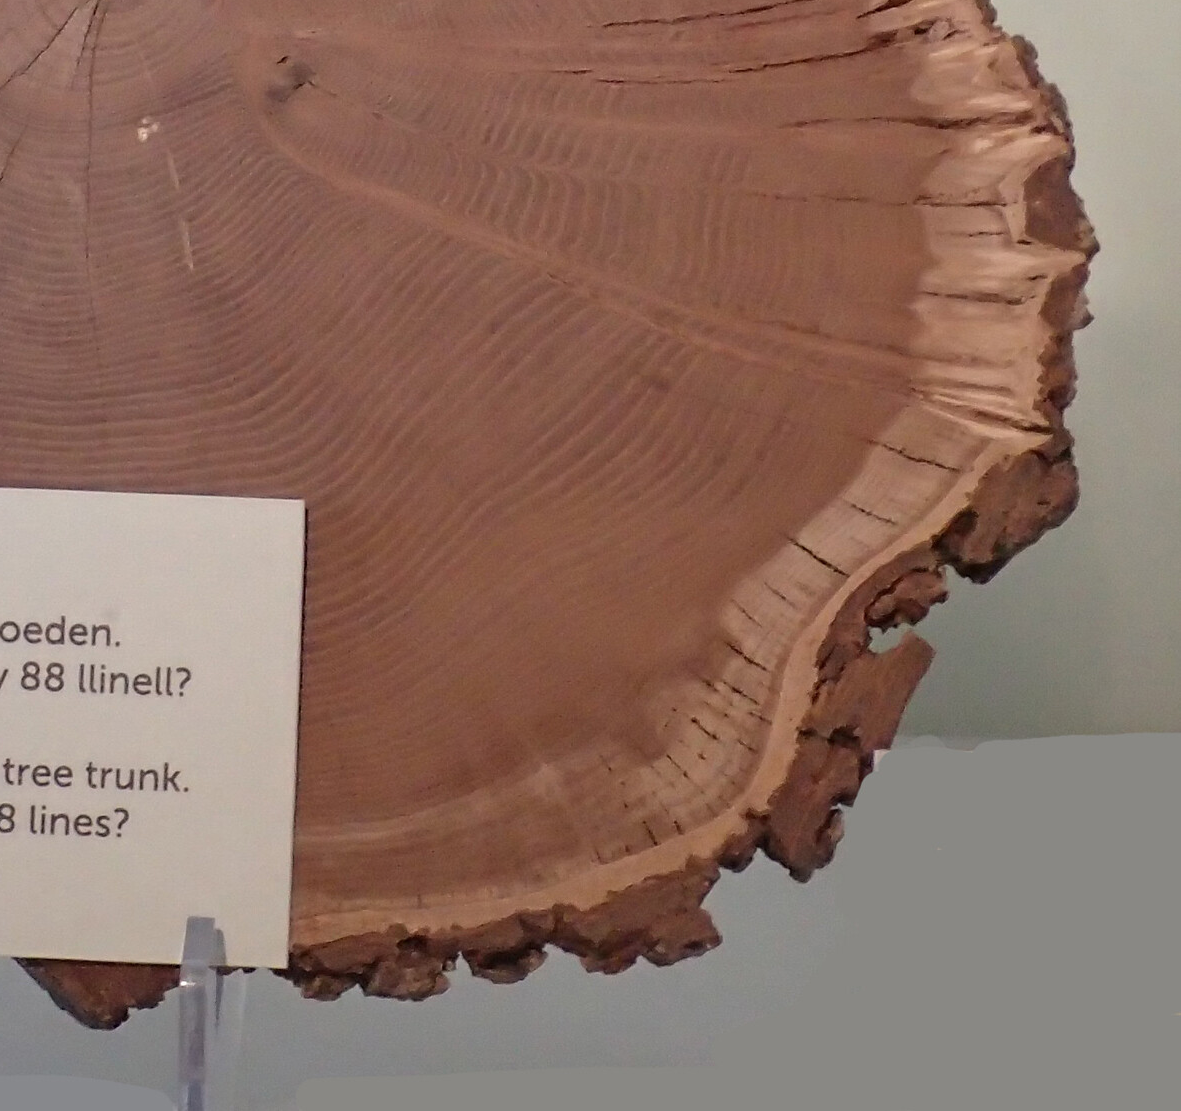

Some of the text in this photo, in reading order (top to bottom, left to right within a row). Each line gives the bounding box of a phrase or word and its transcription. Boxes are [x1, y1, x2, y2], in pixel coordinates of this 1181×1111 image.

[21, 661, 64, 692] 88
[79, 664, 191, 697] llinell?
[3, 758, 73, 787] tree
[86, 762, 188, 792] trunk.
[30, 805, 129, 837] lines?
